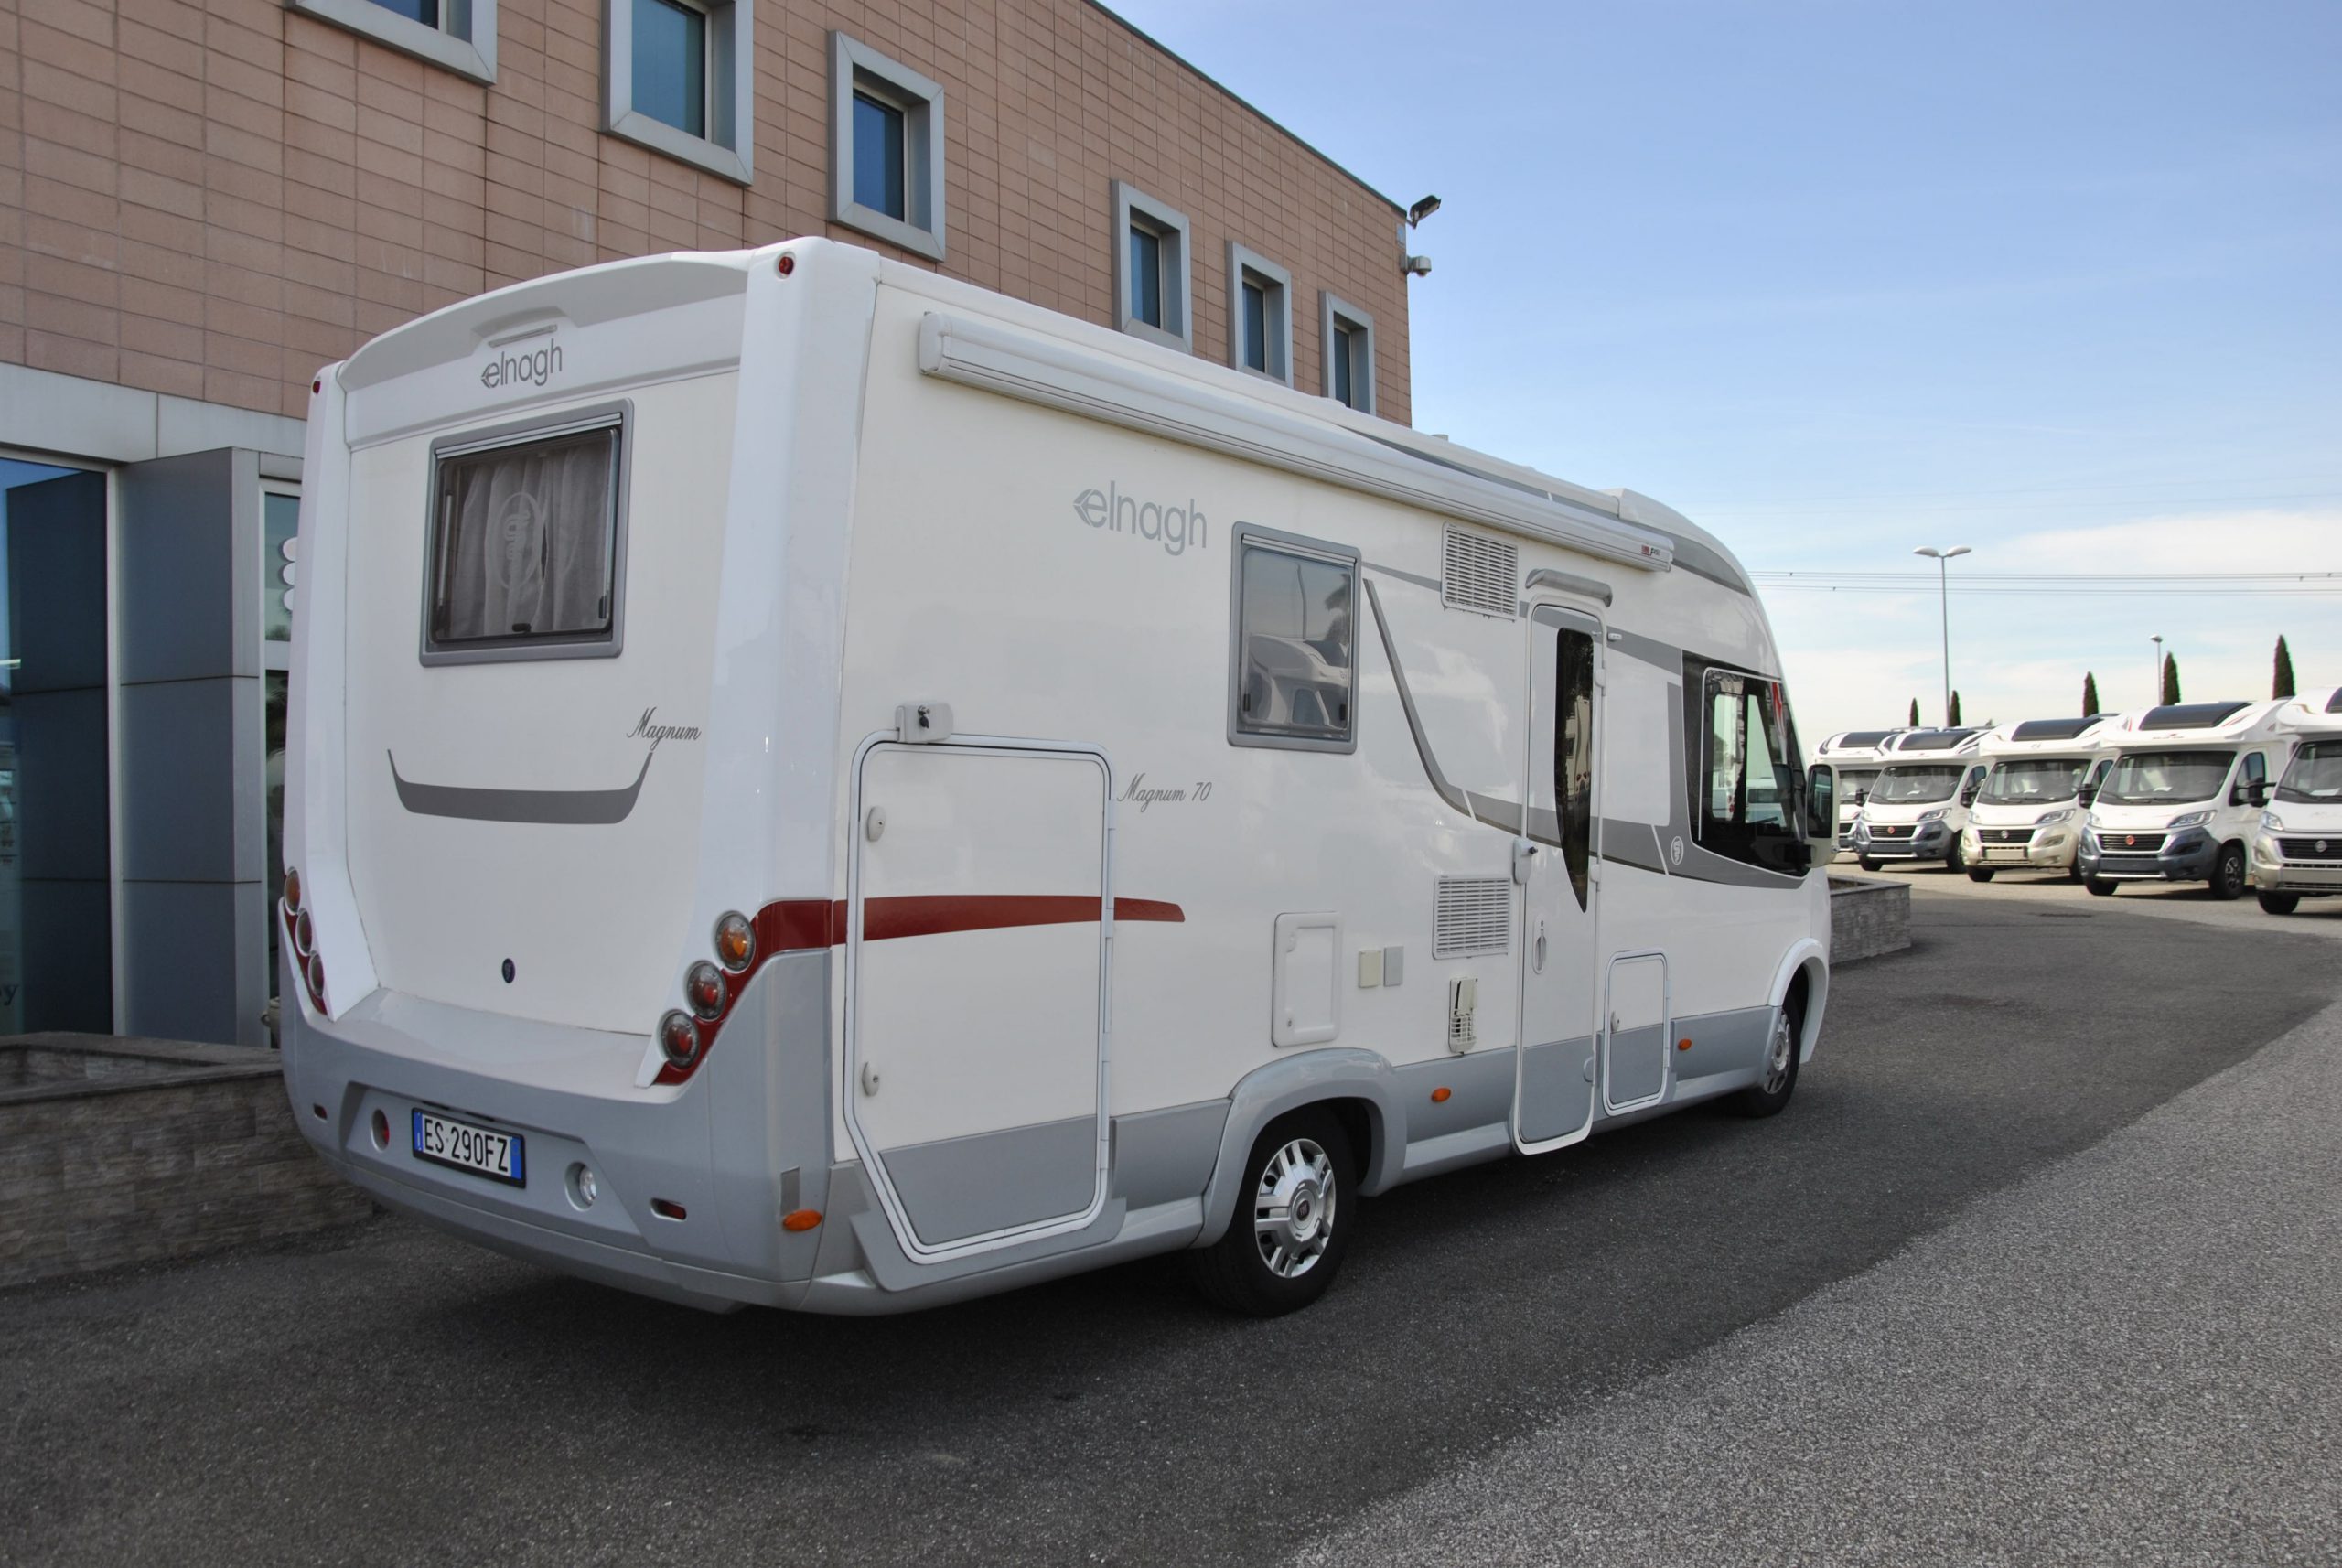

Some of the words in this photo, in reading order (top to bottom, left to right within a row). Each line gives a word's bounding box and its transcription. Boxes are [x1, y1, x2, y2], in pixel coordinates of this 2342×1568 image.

[481, 338, 563, 389] elnagh
[1073, 480, 1208, 556] elnagh
[626, 706, 702, 751] Magnum
[1117, 772, 1187, 813] Magnum
[1191, 781, 1212, 801] 70
